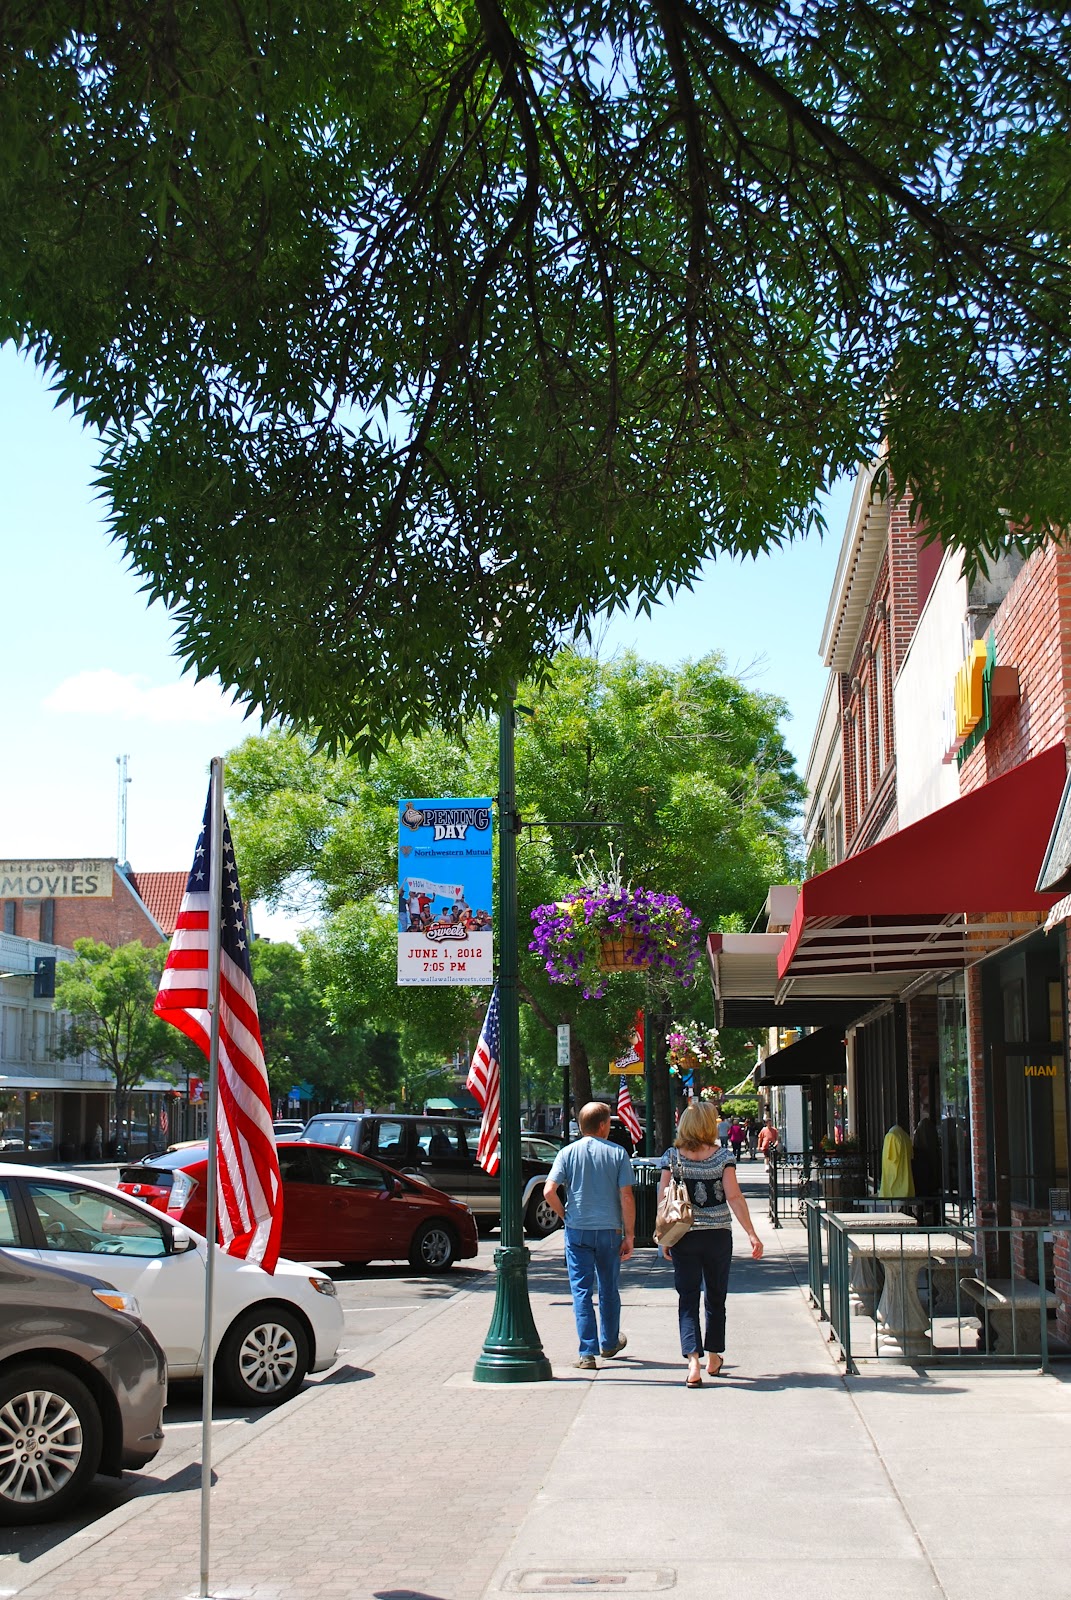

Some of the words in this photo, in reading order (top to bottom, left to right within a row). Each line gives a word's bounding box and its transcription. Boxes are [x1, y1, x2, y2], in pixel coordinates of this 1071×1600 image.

[434, 825, 468, 840] DAY
[414, 849, 464, 857] Northwestern
[465, 848, 491, 856] Mutual
[0, 875, 99, 895] MOVIES
[426, 922, 467, 941] Sweets
[407, 949, 438, 959] JUNE
[444, 949, 453, 960] 1,
[457, 948, 482, 958] 2012
[423, 962, 445, 972] 7:05
[450, 962, 466, 972] PM
